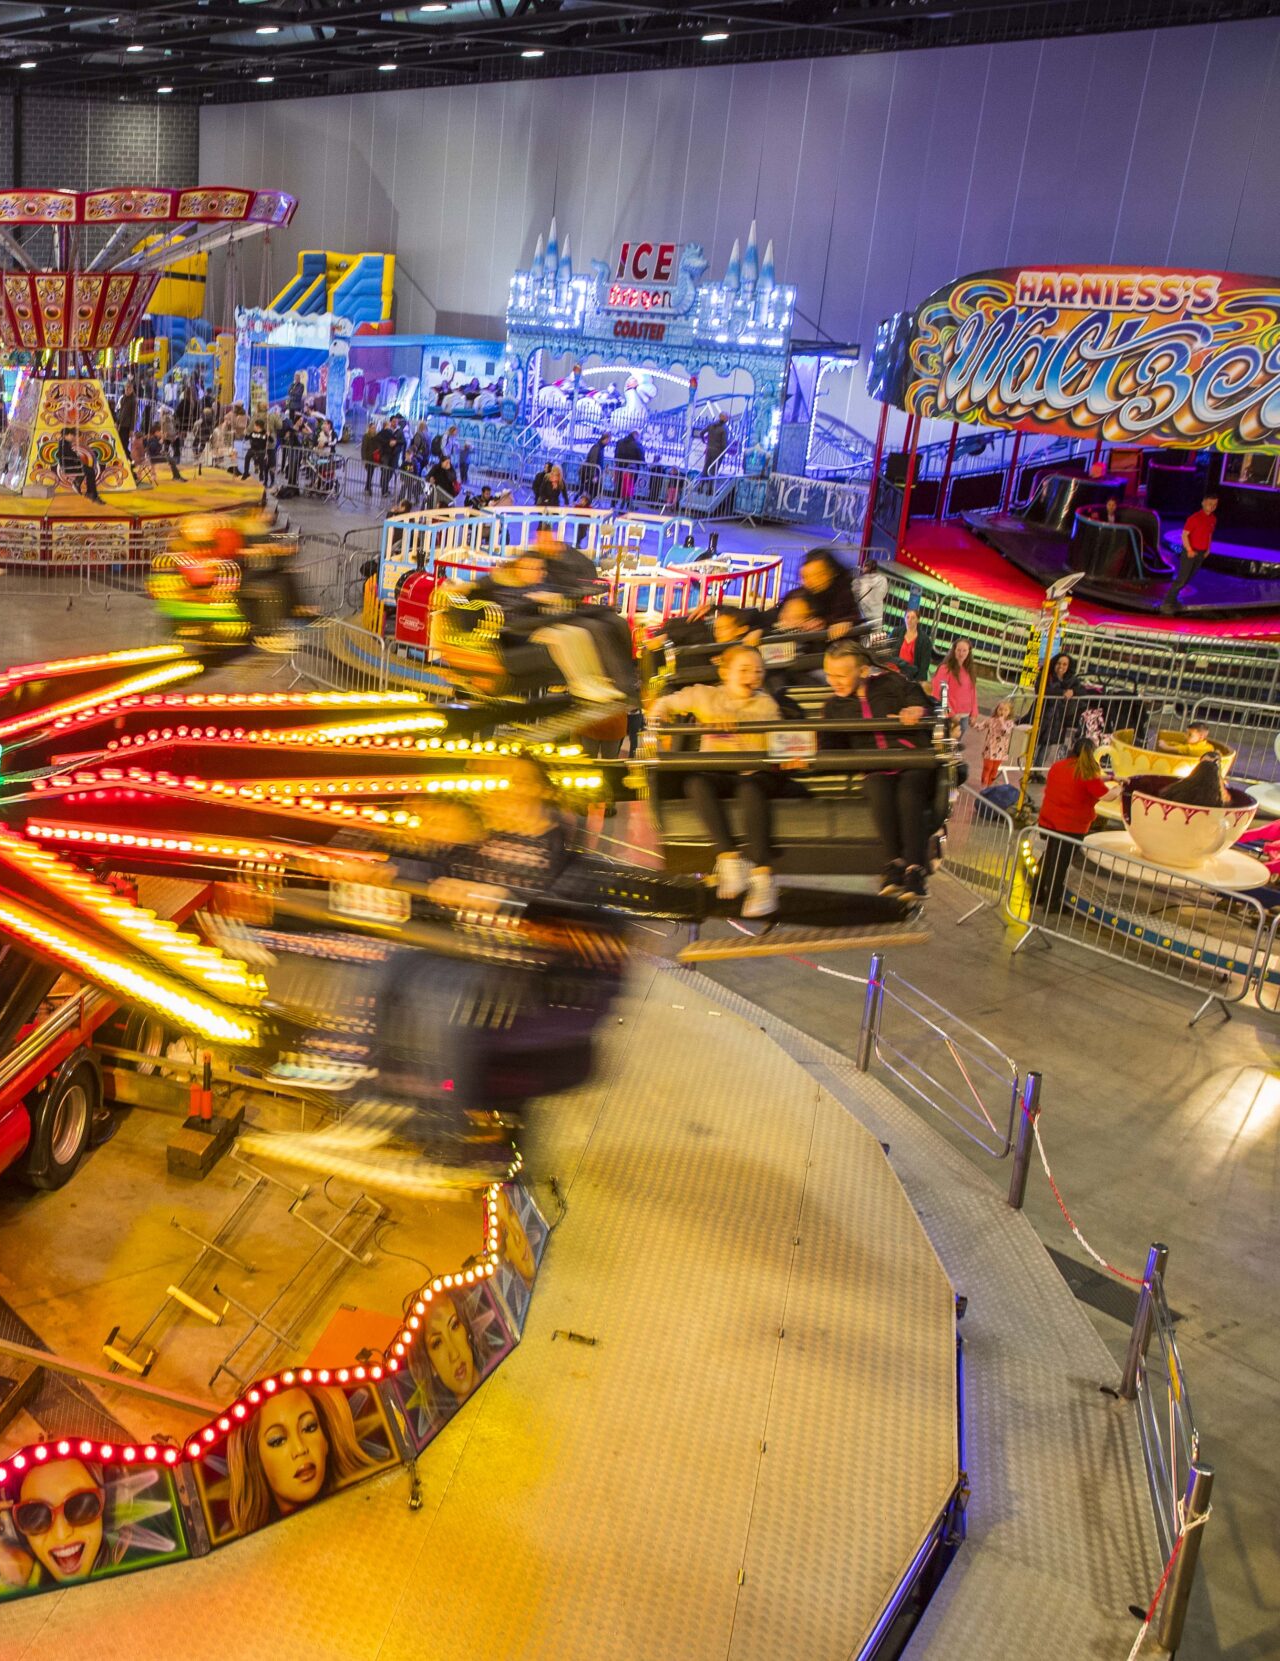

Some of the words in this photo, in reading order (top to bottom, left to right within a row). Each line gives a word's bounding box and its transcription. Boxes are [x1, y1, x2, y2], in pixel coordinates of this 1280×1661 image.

[615, 241, 677, 281] ICE
[1016, 271, 1221, 313] HARNIESS'S
[613, 319, 666, 341] COASTER
[942, 306, 1280, 434] Waltze
[776, 480, 810, 516] ICE
